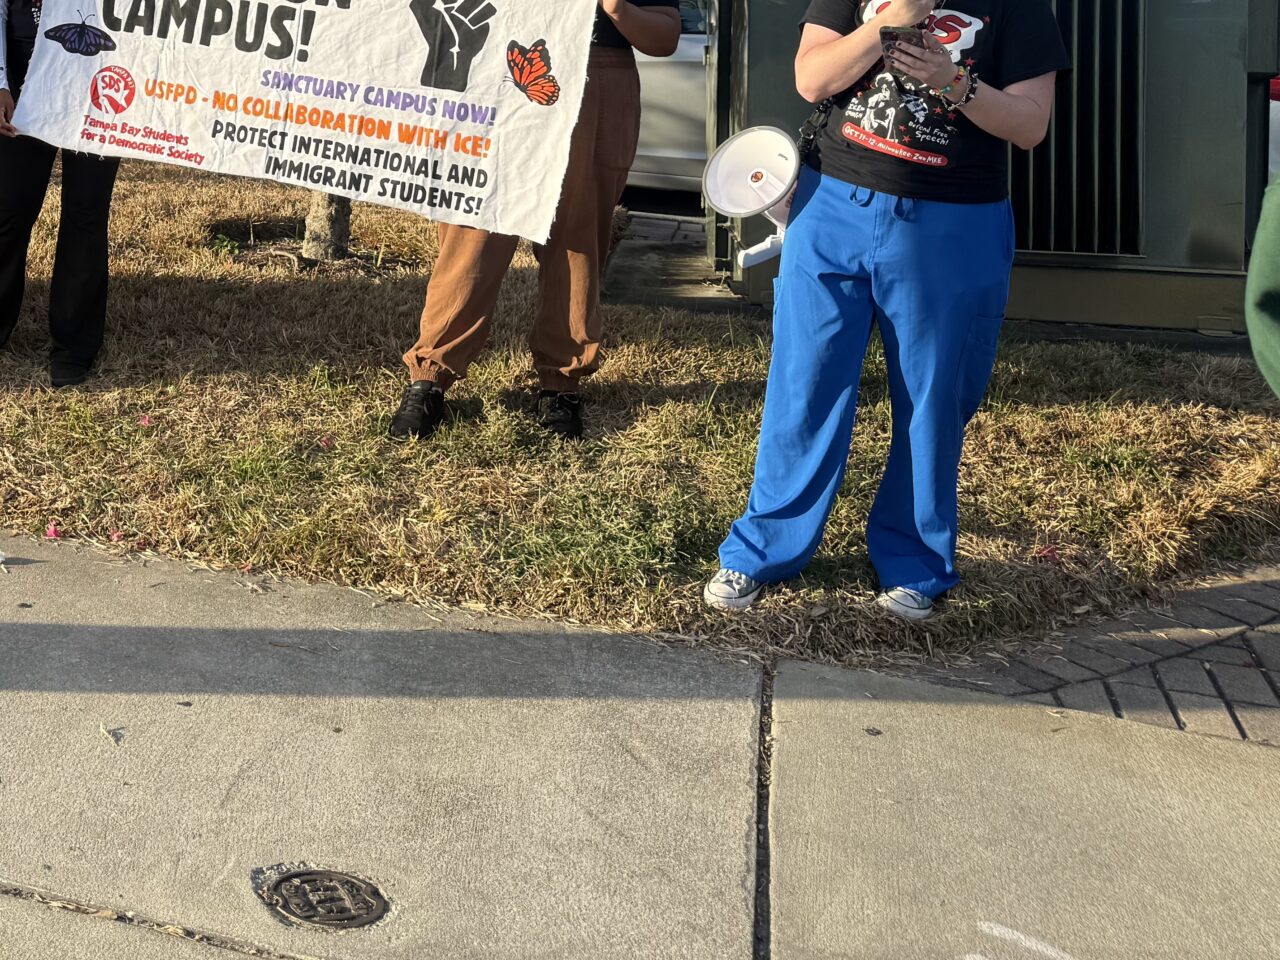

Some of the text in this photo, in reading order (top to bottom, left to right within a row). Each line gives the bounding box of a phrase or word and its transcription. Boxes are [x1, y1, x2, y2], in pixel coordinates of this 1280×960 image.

[101, 74, 122, 93] SDS
[260, 69, 497, 126] SANCTUARY CAMPUS NOW!
[83, 114, 189, 146] Tampa Bay Students
[144, 78, 198, 105] USFPD
[212, 90, 238, 112] NO
[242, 96, 392, 141] COLLABORATION
[397, 122, 449, 150] WITH
[453, 132, 491, 159] ICE!
[908, 121, 949, 138] Defend Free
[80, 128, 205, 165] for a Democratic Society
[211, 119, 488, 188] PROTECT INTERNATIONAL AND
[915, 130, 949, 146] Speech!
[265, 156, 484, 216] IMMIGRANT STUDENTS!
